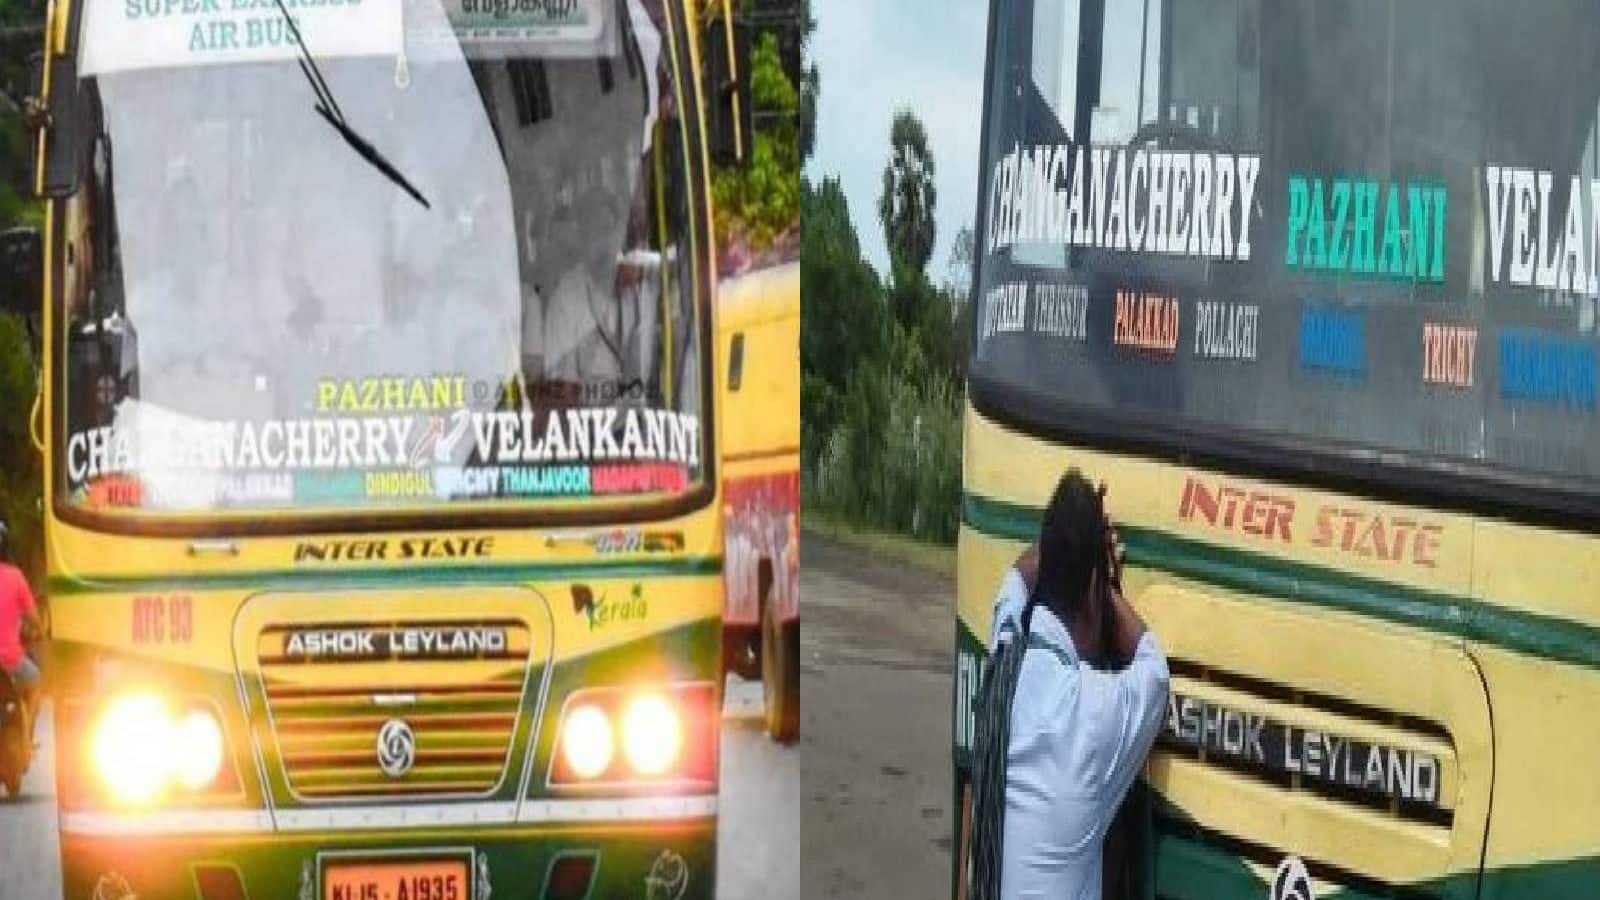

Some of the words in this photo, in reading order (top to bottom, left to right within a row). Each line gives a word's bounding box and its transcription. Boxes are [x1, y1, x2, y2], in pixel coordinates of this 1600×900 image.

[189, 21, 238, 51] AIR
[1286, 176, 1448, 282] PAZHANI
[1423, 323, 1477, 387] TRICHY
[317, 377, 466, 410] PAZHANI
[470, 407, 699, 465] VELANKANNI
[294, 539, 387, 562] INTER
[399, 536, 494, 561] STATE
[1178, 477, 1296, 544] INTER
[1312, 504, 1444, 569] STATE
[286, 631, 374, 656] ASHOK
[390, 628, 505, 653] LEYLAND
[1284, 726, 1440, 802] LEYLAND
